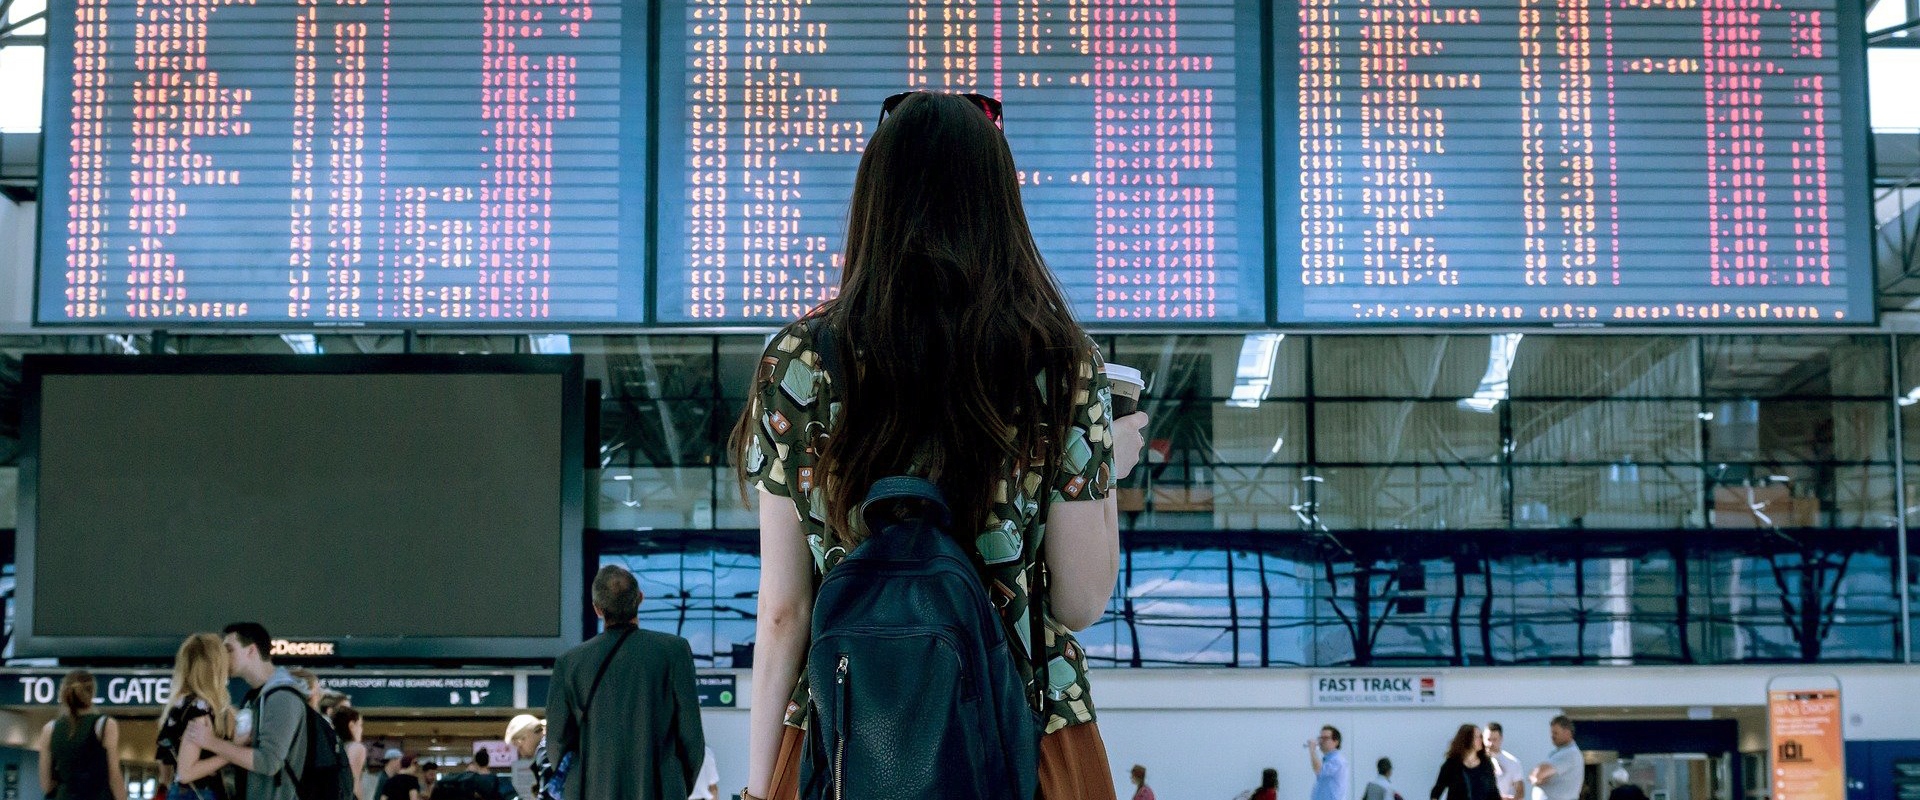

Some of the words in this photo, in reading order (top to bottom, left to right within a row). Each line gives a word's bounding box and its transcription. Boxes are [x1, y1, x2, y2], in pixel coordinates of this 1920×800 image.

[19, 677, 55, 703] TO
[349, 679, 387, 688] PASSPORT
[388, 679, 404, 688] AND
[405, 679, 443, 688] BOARDING
[444, 679, 463, 688] PASS
[464, 679, 490, 688] READY
[1319, 678, 1356, 691] FAST
[1362, 678, 1412, 691] TRACK
